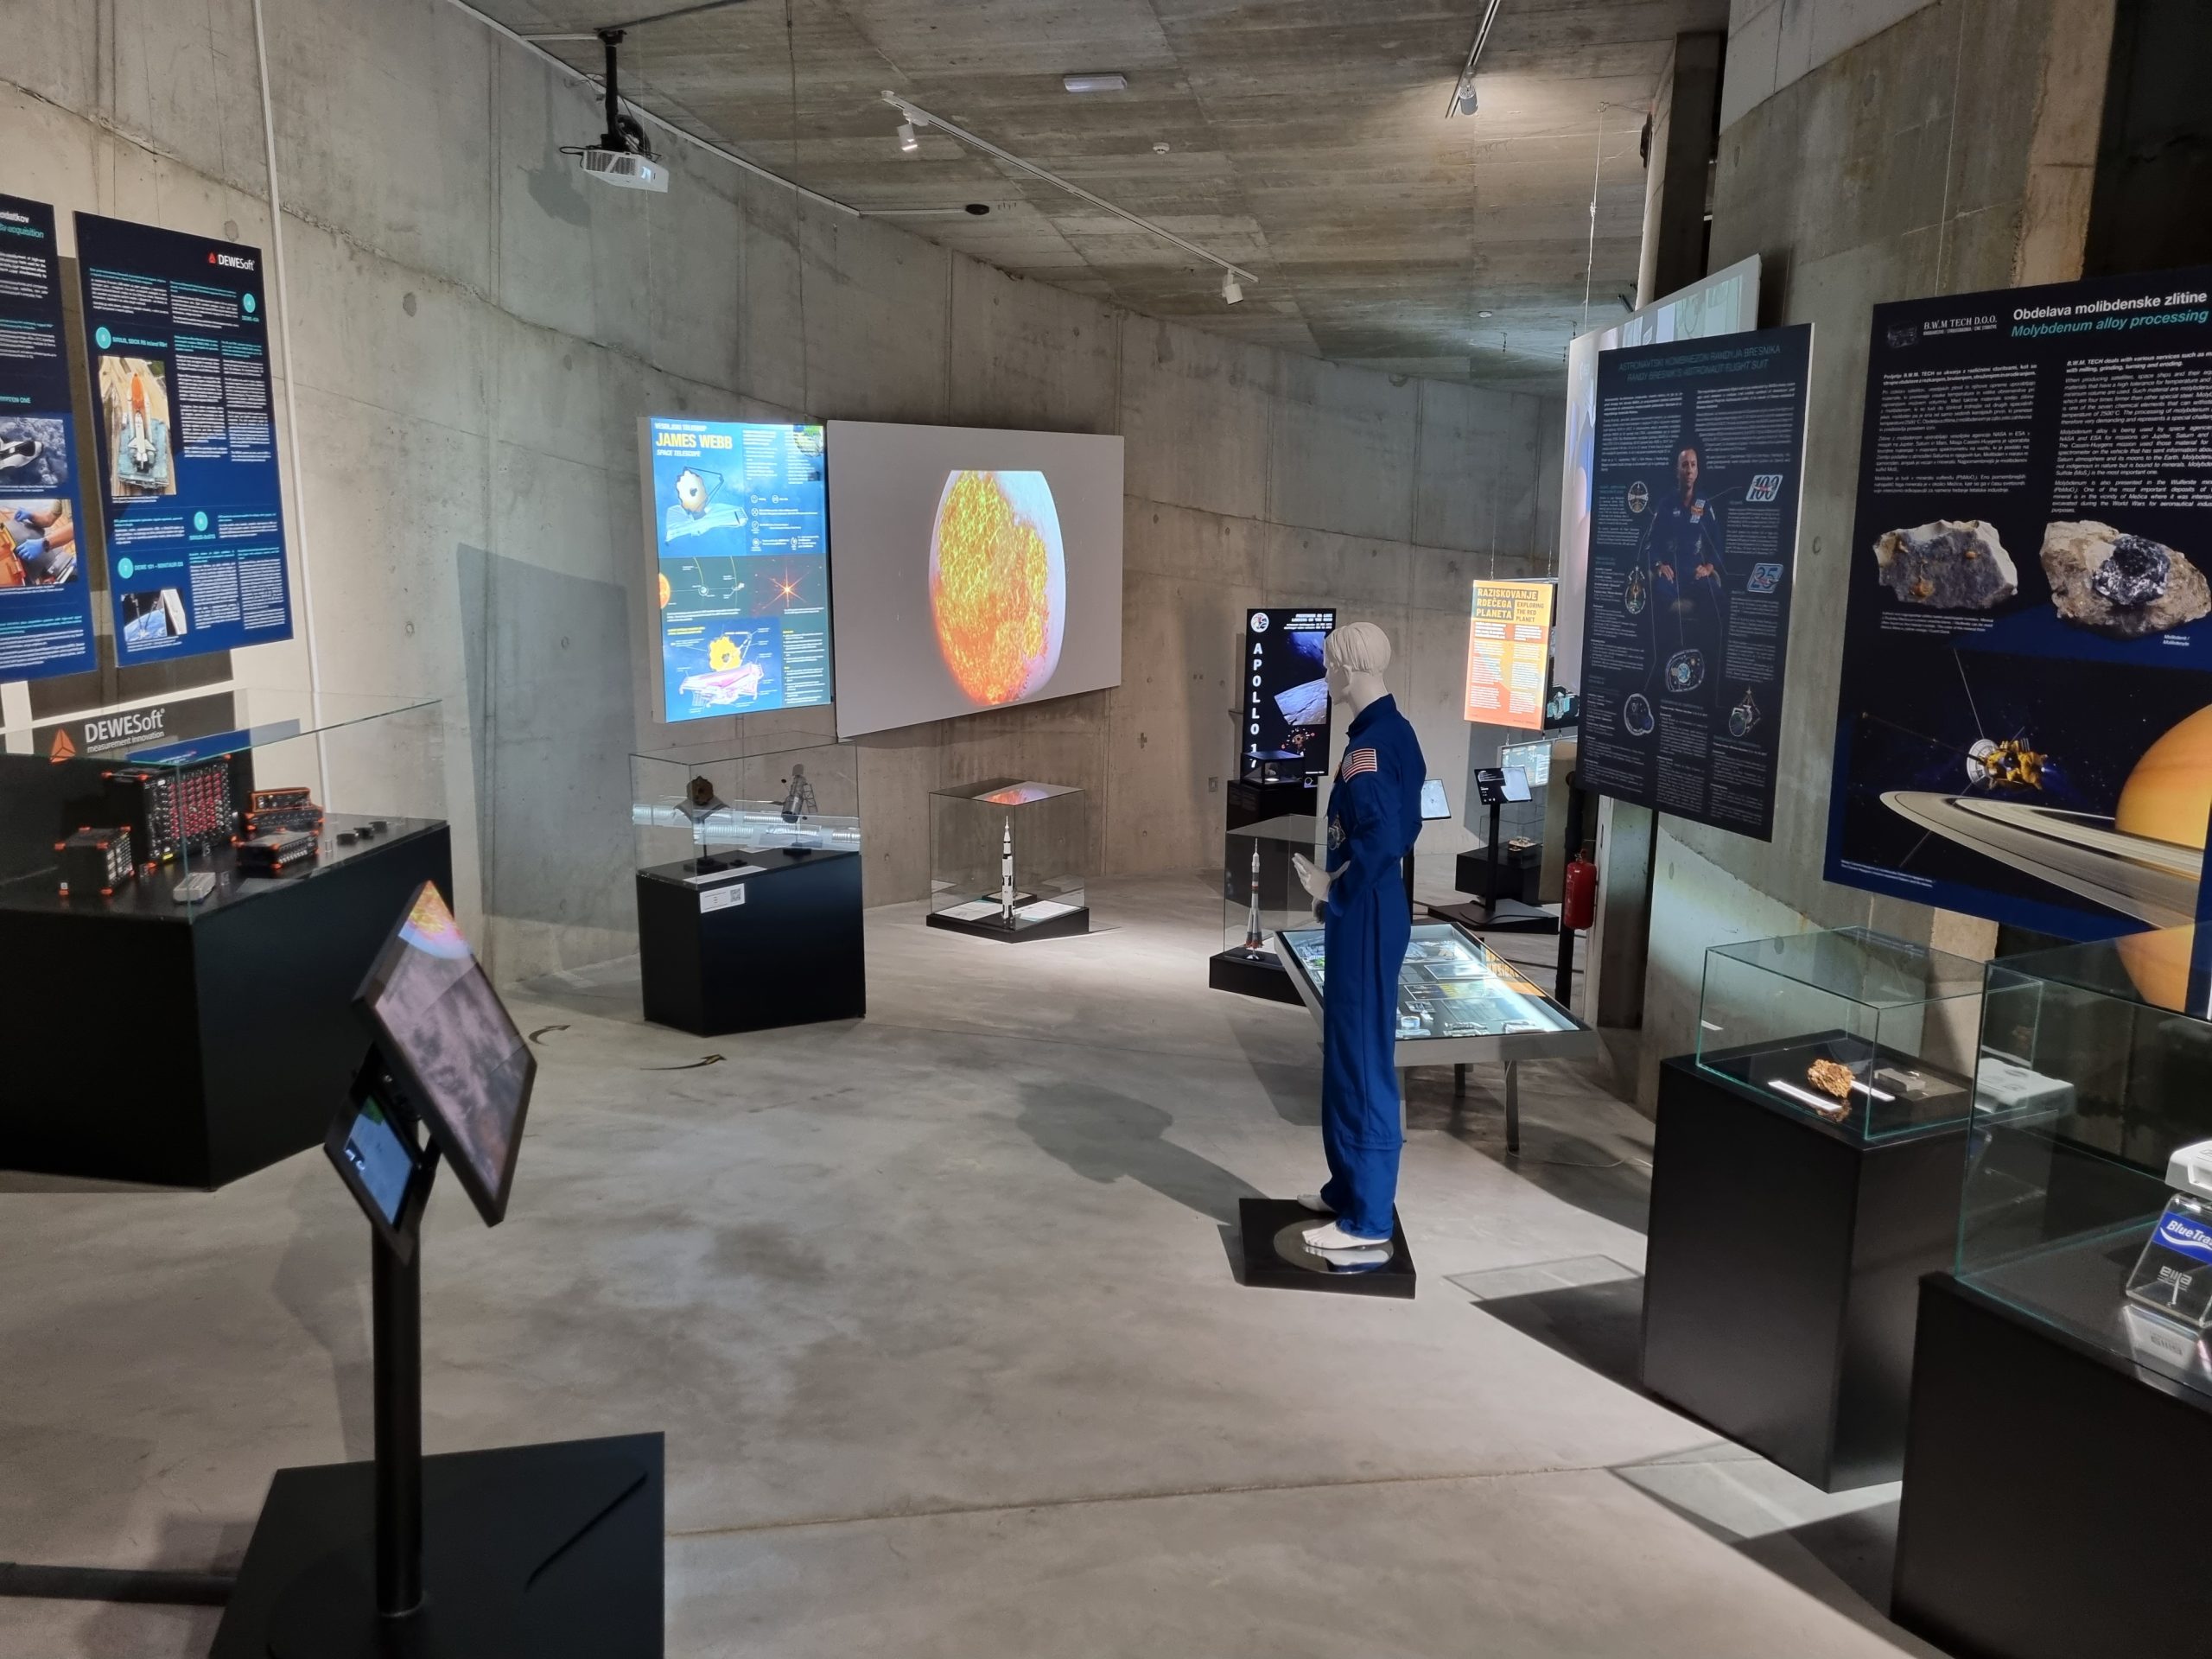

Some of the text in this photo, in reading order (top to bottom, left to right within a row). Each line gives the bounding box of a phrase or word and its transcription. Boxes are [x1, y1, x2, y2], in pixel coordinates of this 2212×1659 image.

[218, 254, 255, 271] DEWESoft
[2013, 290, 2208, 321] Obdelava molibdenske zlitine
[1949, 317, 1973, 327] TECH
[1974, 315, 1998, 325] D.O.O.
[2011, 320, 2093, 338] Molybdenum
[2095, 316, 2127, 331] alloy
[2128, 309, 2209, 329] processing
[655, 432, 733, 449] JAMES WEBB
[1477, 588, 1537, 600] RAZISKOVANJE
[1477, 598, 1513, 609] RDEČEGA
[1476, 607, 1513, 619] PLANETA
[1250, 642, 1263, 734] APOLLO
[85, 708, 165, 743] DEWESoft
[86, 730, 165, 753] measurement innovation
